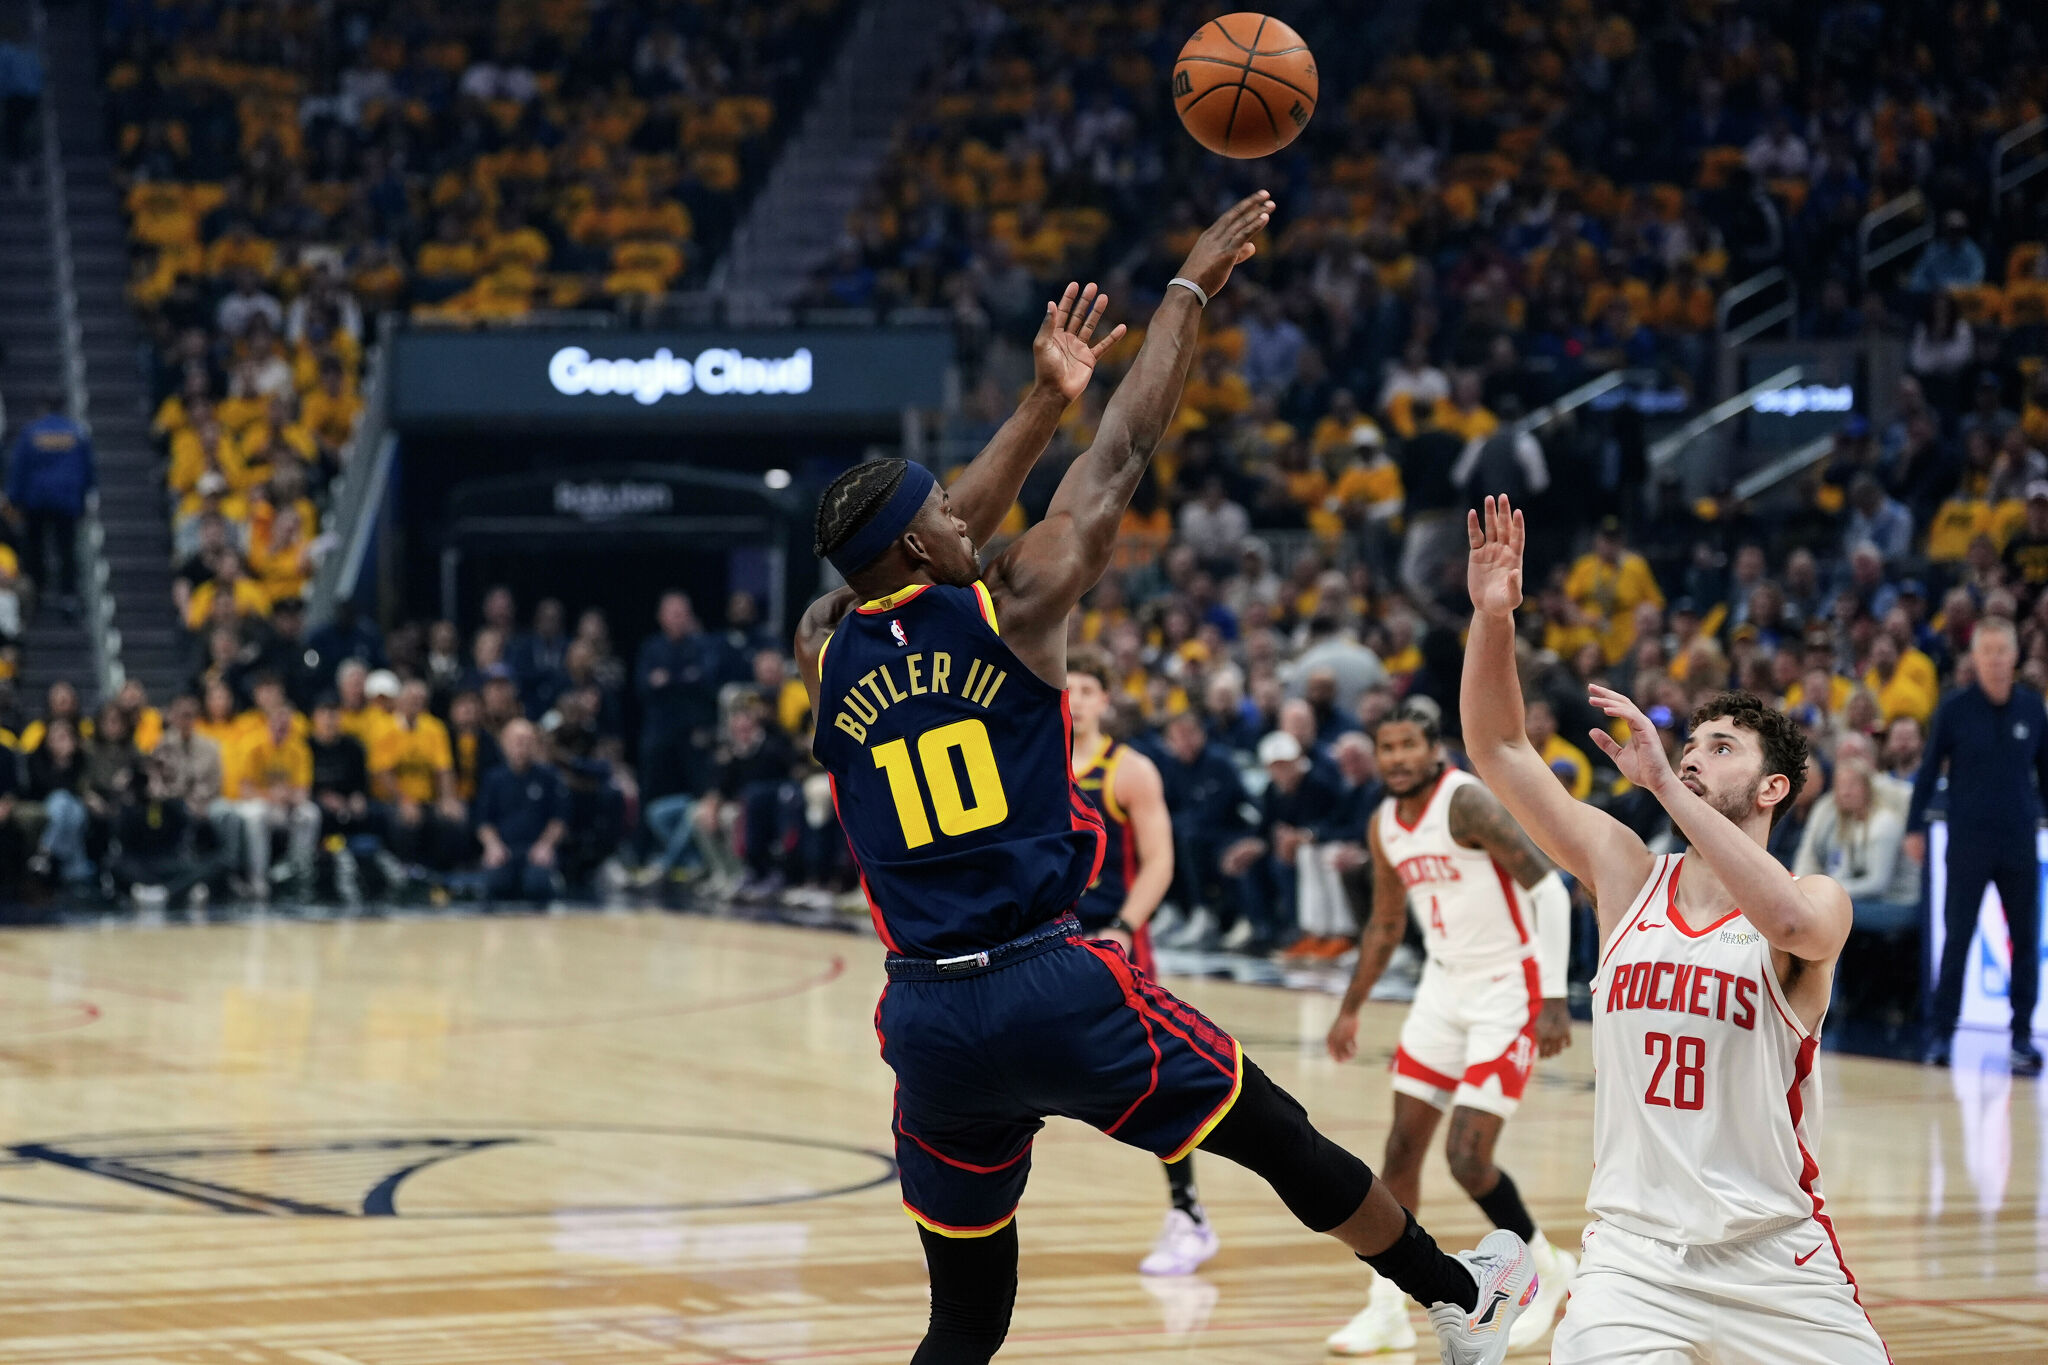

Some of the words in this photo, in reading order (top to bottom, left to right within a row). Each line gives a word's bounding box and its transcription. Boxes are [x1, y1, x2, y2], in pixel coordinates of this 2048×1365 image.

[549, 346, 693, 405] Google
[694, 348, 812, 395] Cloud
[834, 651, 951, 745] BUTLER
[961, 658, 1007, 708] III
[871, 718, 1008, 850] 10
[1432, 895, 1447, 938] 4
[1607, 961, 1758, 1031] ROCKETS
[1645, 1031, 1706, 1111] 28
